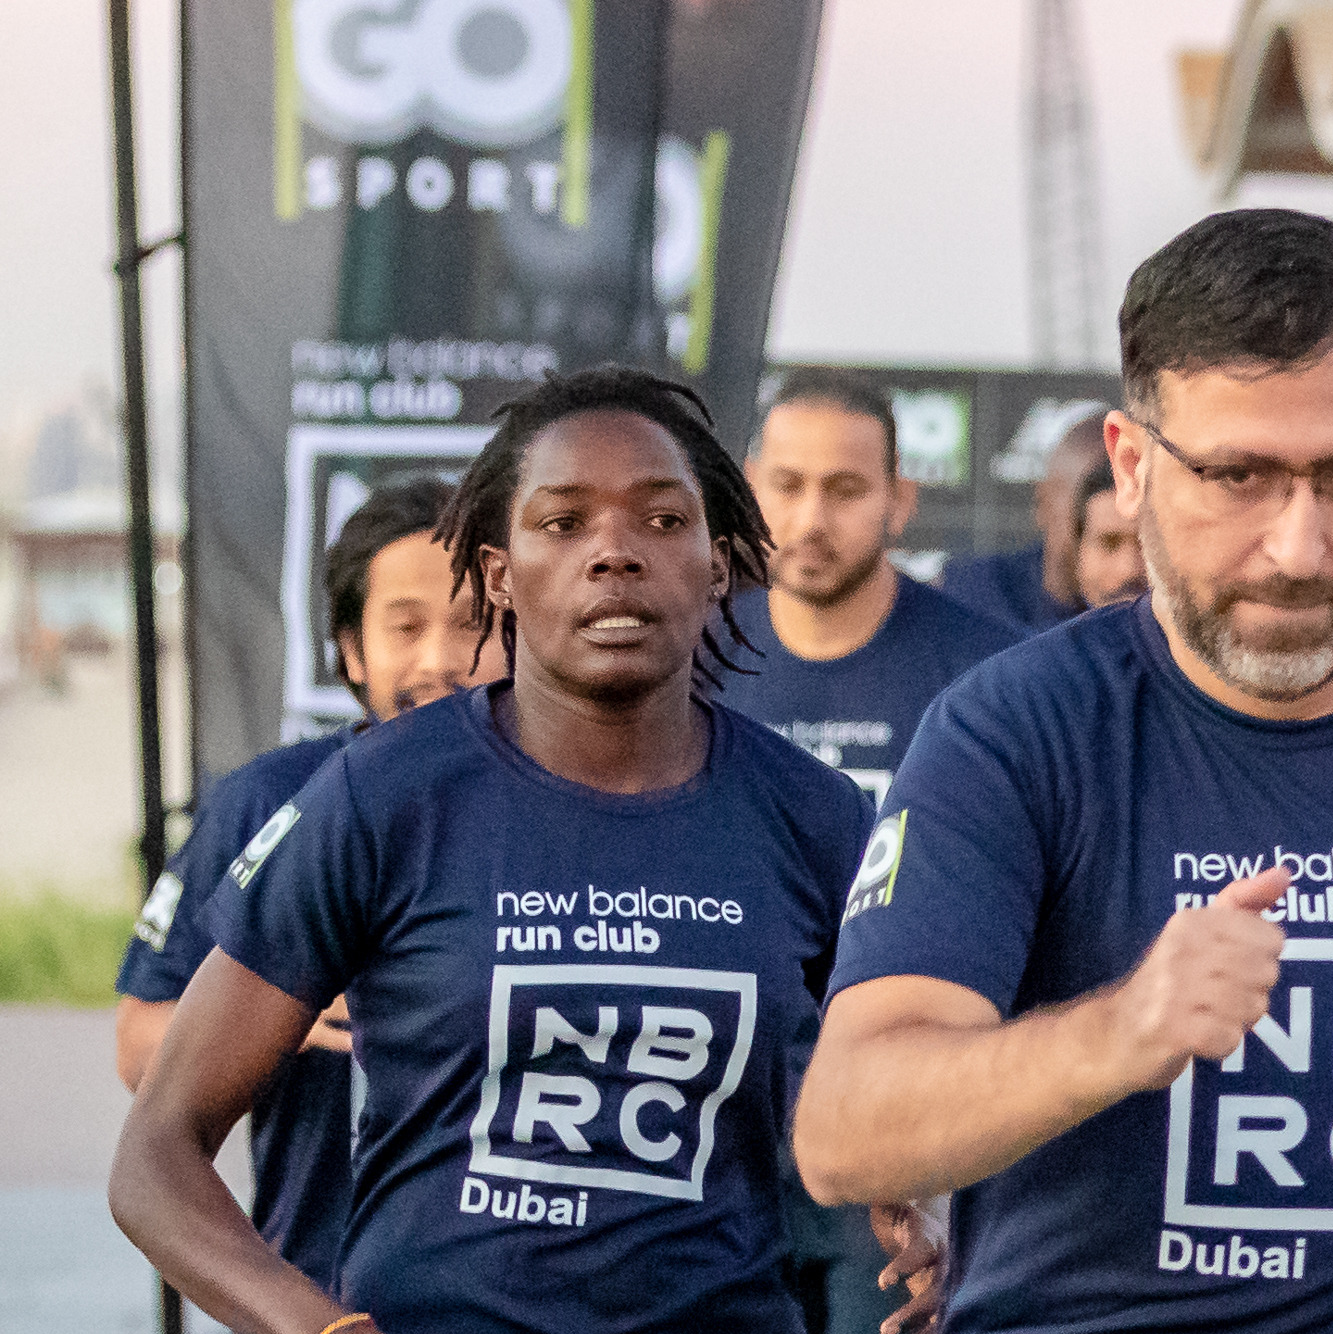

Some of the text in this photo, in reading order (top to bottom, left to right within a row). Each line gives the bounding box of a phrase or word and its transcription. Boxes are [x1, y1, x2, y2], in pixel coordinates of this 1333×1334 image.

[294, 0, 572, 148] GO
[303, 157, 560, 211] SPORT
[1174, 850, 1263, 883] new
[497, 884, 744, 925] new balance
[497, 920, 661, 954] run club
[532, 1005, 717, 1082] NB
[511, 1073, 688, 1164] RC
[458, 1176, 589, 1228] Dubai
[1158, 1231, 1305, 1280] Dubai
